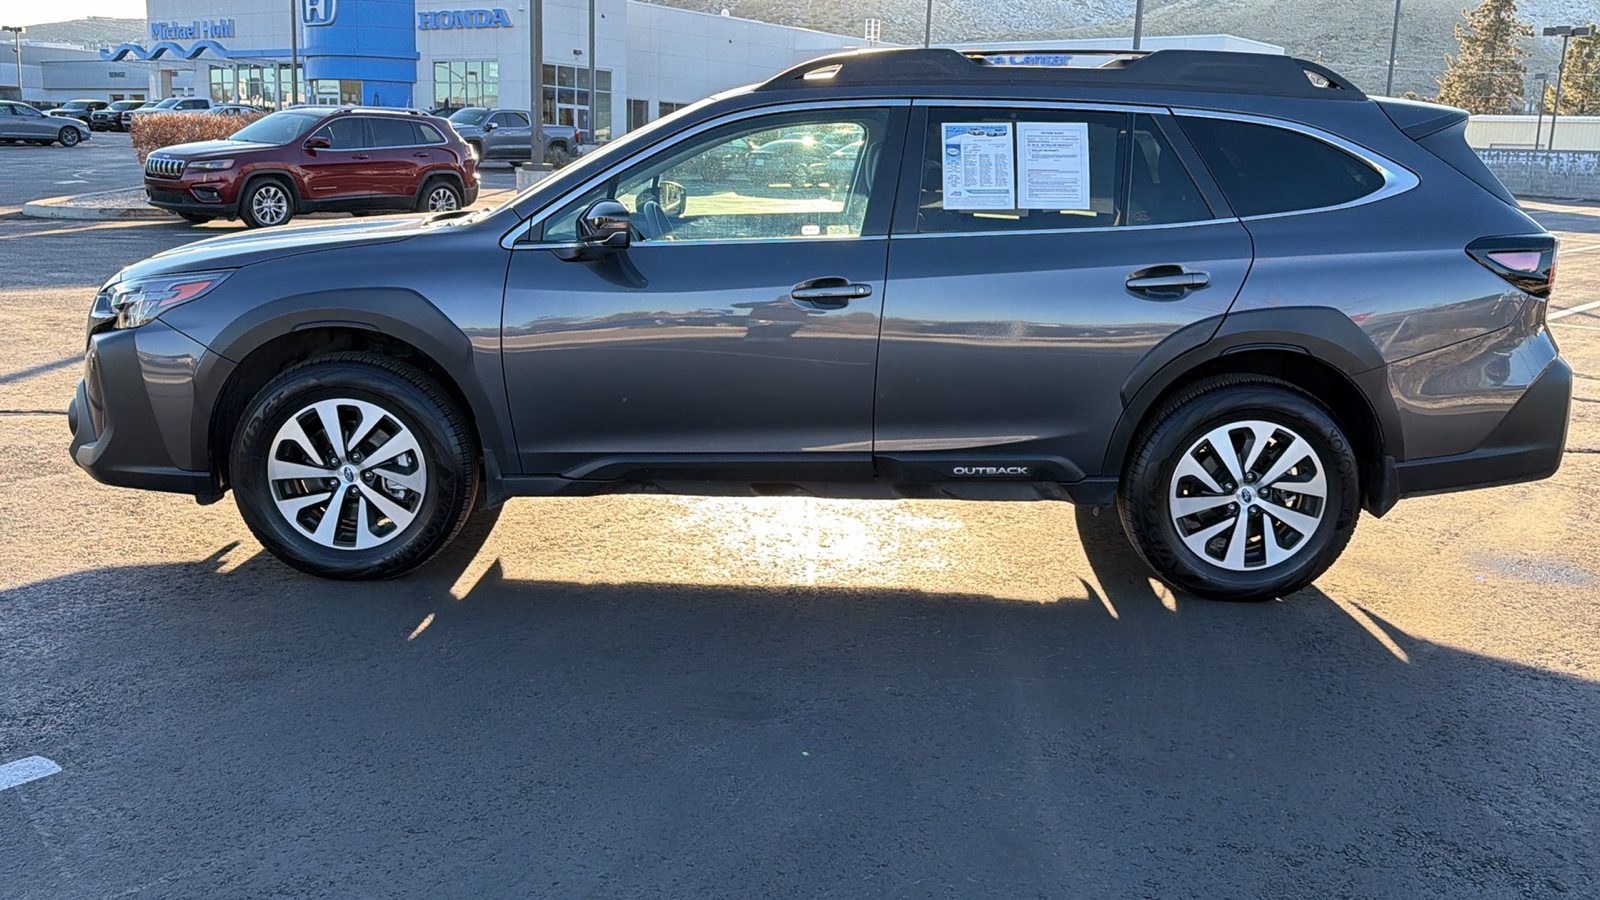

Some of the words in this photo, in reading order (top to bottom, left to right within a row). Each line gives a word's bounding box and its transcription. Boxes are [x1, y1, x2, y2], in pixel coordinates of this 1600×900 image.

[418, 9, 513, 30] HONDA
[151, 20, 200, 40] Michael
[201, 18, 235, 38] Hohl
[1009, 54, 1073, 66] Center
[953, 466, 1028, 475] OUTBACK
